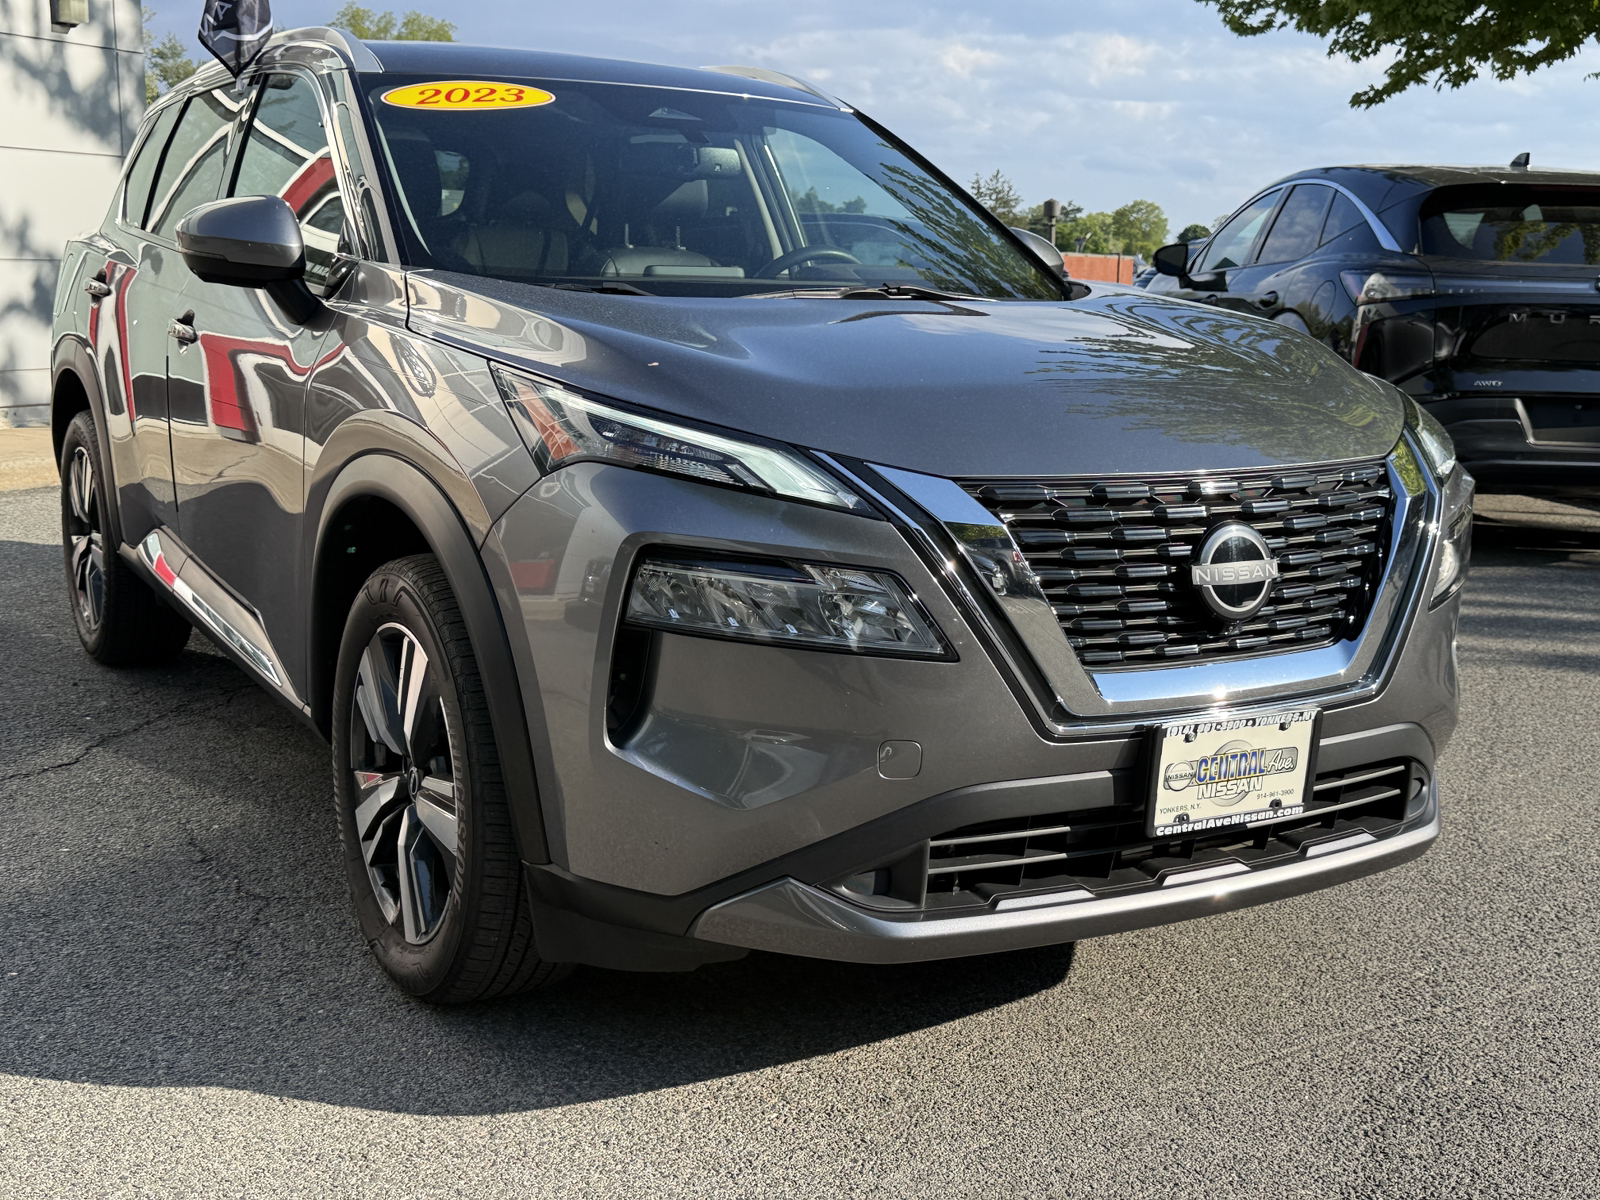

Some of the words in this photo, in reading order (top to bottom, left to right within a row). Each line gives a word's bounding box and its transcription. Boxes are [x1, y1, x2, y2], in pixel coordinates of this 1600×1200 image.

[416, 87, 526, 105] 2023
[1195, 562, 1277, 583] NISSAN
[1167, 772, 1194, 780] NISSAN
[1195, 748, 1267, 785] CENTRAL
[1267, 749, 1294, 773] Ave.
[1197, 775, 1264, 800] NISSAN
[1256, 788, 1295, 800] 914-961-3900
[1159, 803, 1189, 815] YONKERS,
[1190, 803, 1202, 811] N.Y.
[1156, 806, 1304, 837] CentralAveNissan.com
